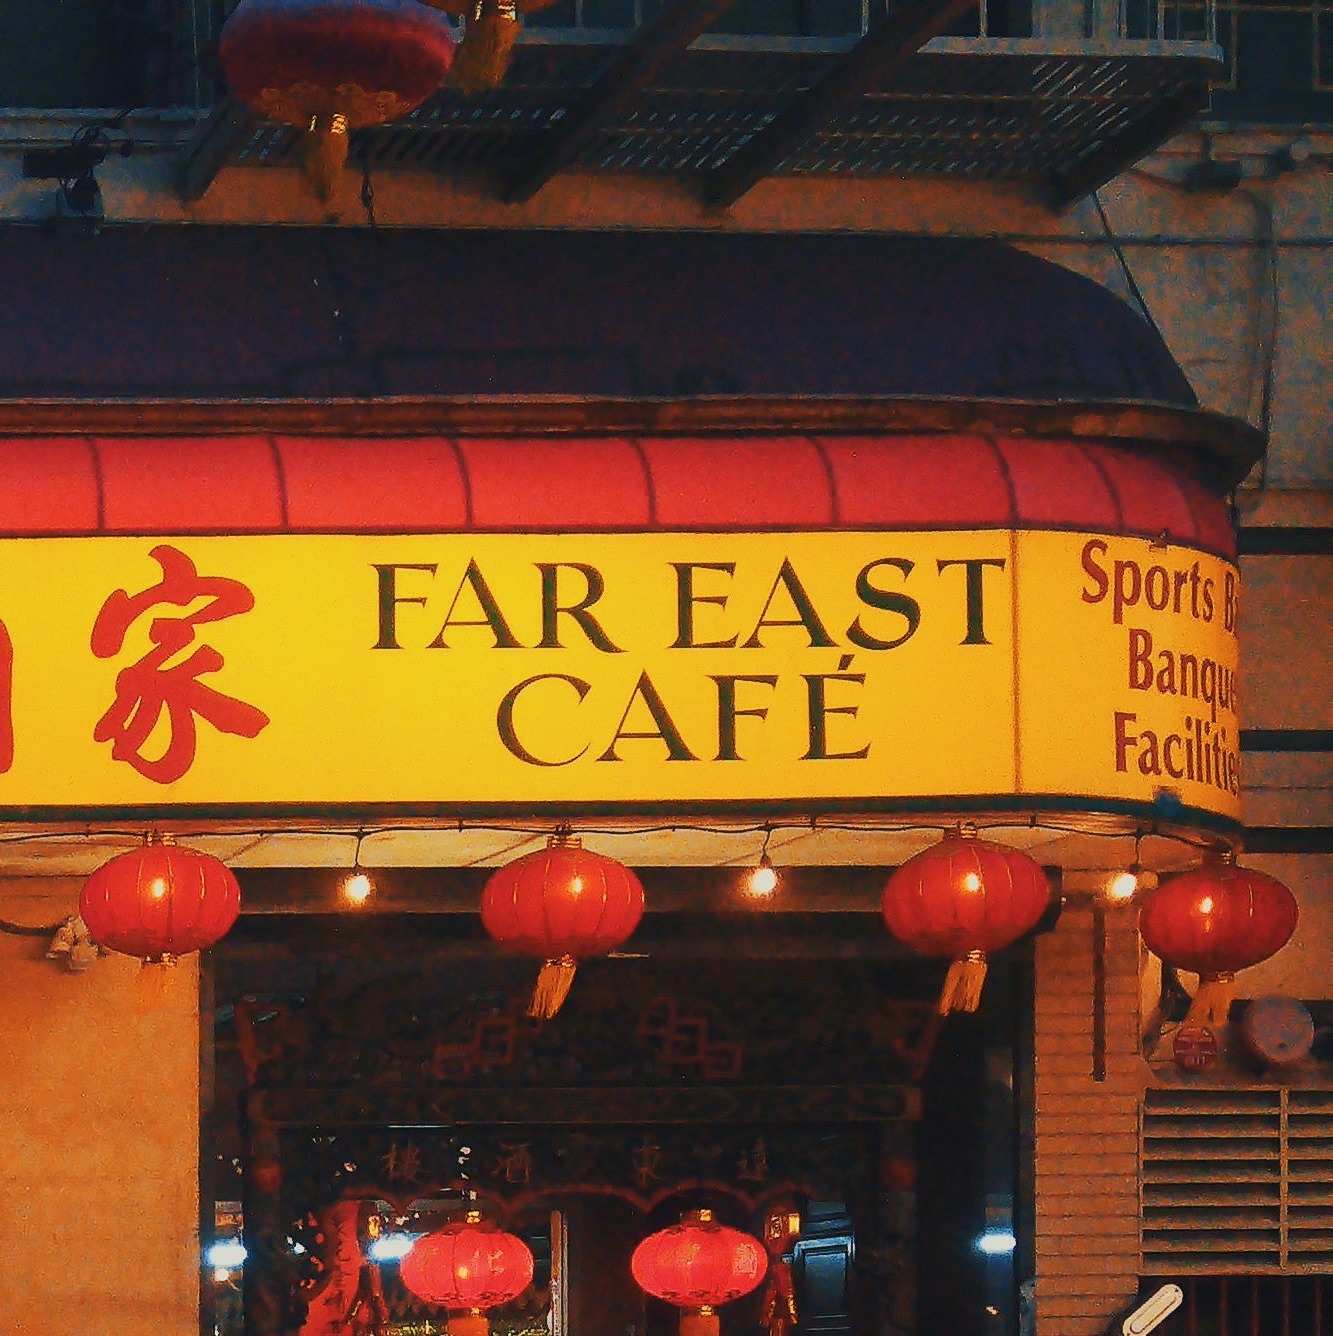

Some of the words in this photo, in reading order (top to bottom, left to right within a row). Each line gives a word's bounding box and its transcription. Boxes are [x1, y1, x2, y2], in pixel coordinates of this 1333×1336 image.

[370, 556, 627, 654] FAR
[667, 556, 1006, 652] EAST
[1081, 538, 1214, 625] Sports
[497, 654, 870, 768] CAFÉ
[1128, 628, 1235, 723] Banqu
